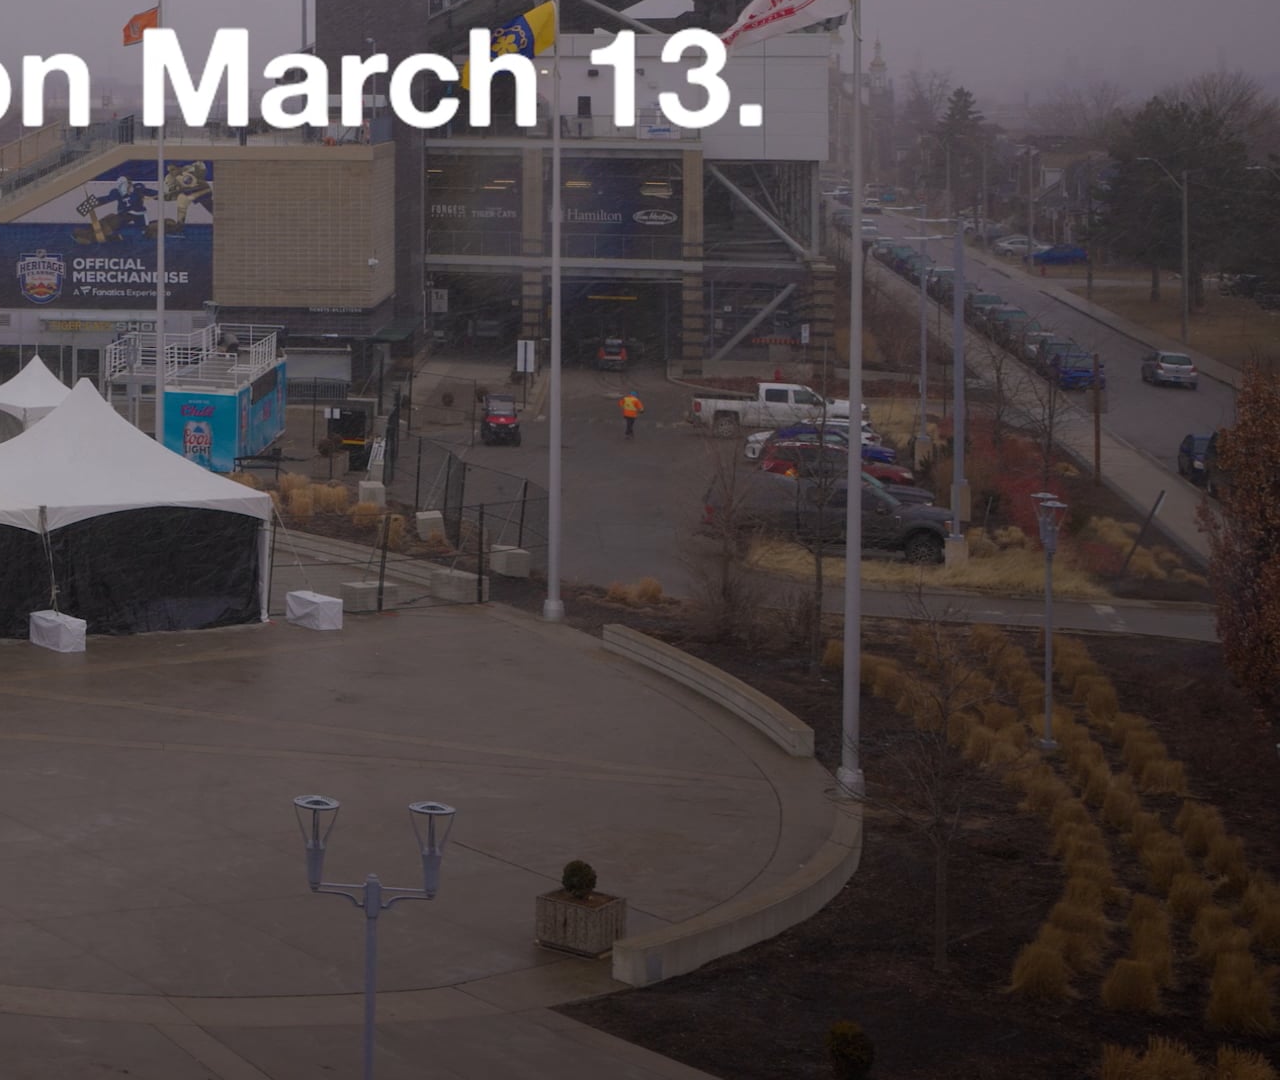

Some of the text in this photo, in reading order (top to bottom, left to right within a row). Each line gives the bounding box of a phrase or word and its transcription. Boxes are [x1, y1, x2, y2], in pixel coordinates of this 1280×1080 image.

[567, 209, 622, 221] Hamilton
[20, 261, 64, 274] HERITAGE
[72, 258, 146, 270] OFFICIAL
[92, 288, 125, 296] Fanatics
[126, 288, 171, 298] Experiee
[180, 403, 216, 417] Chill
